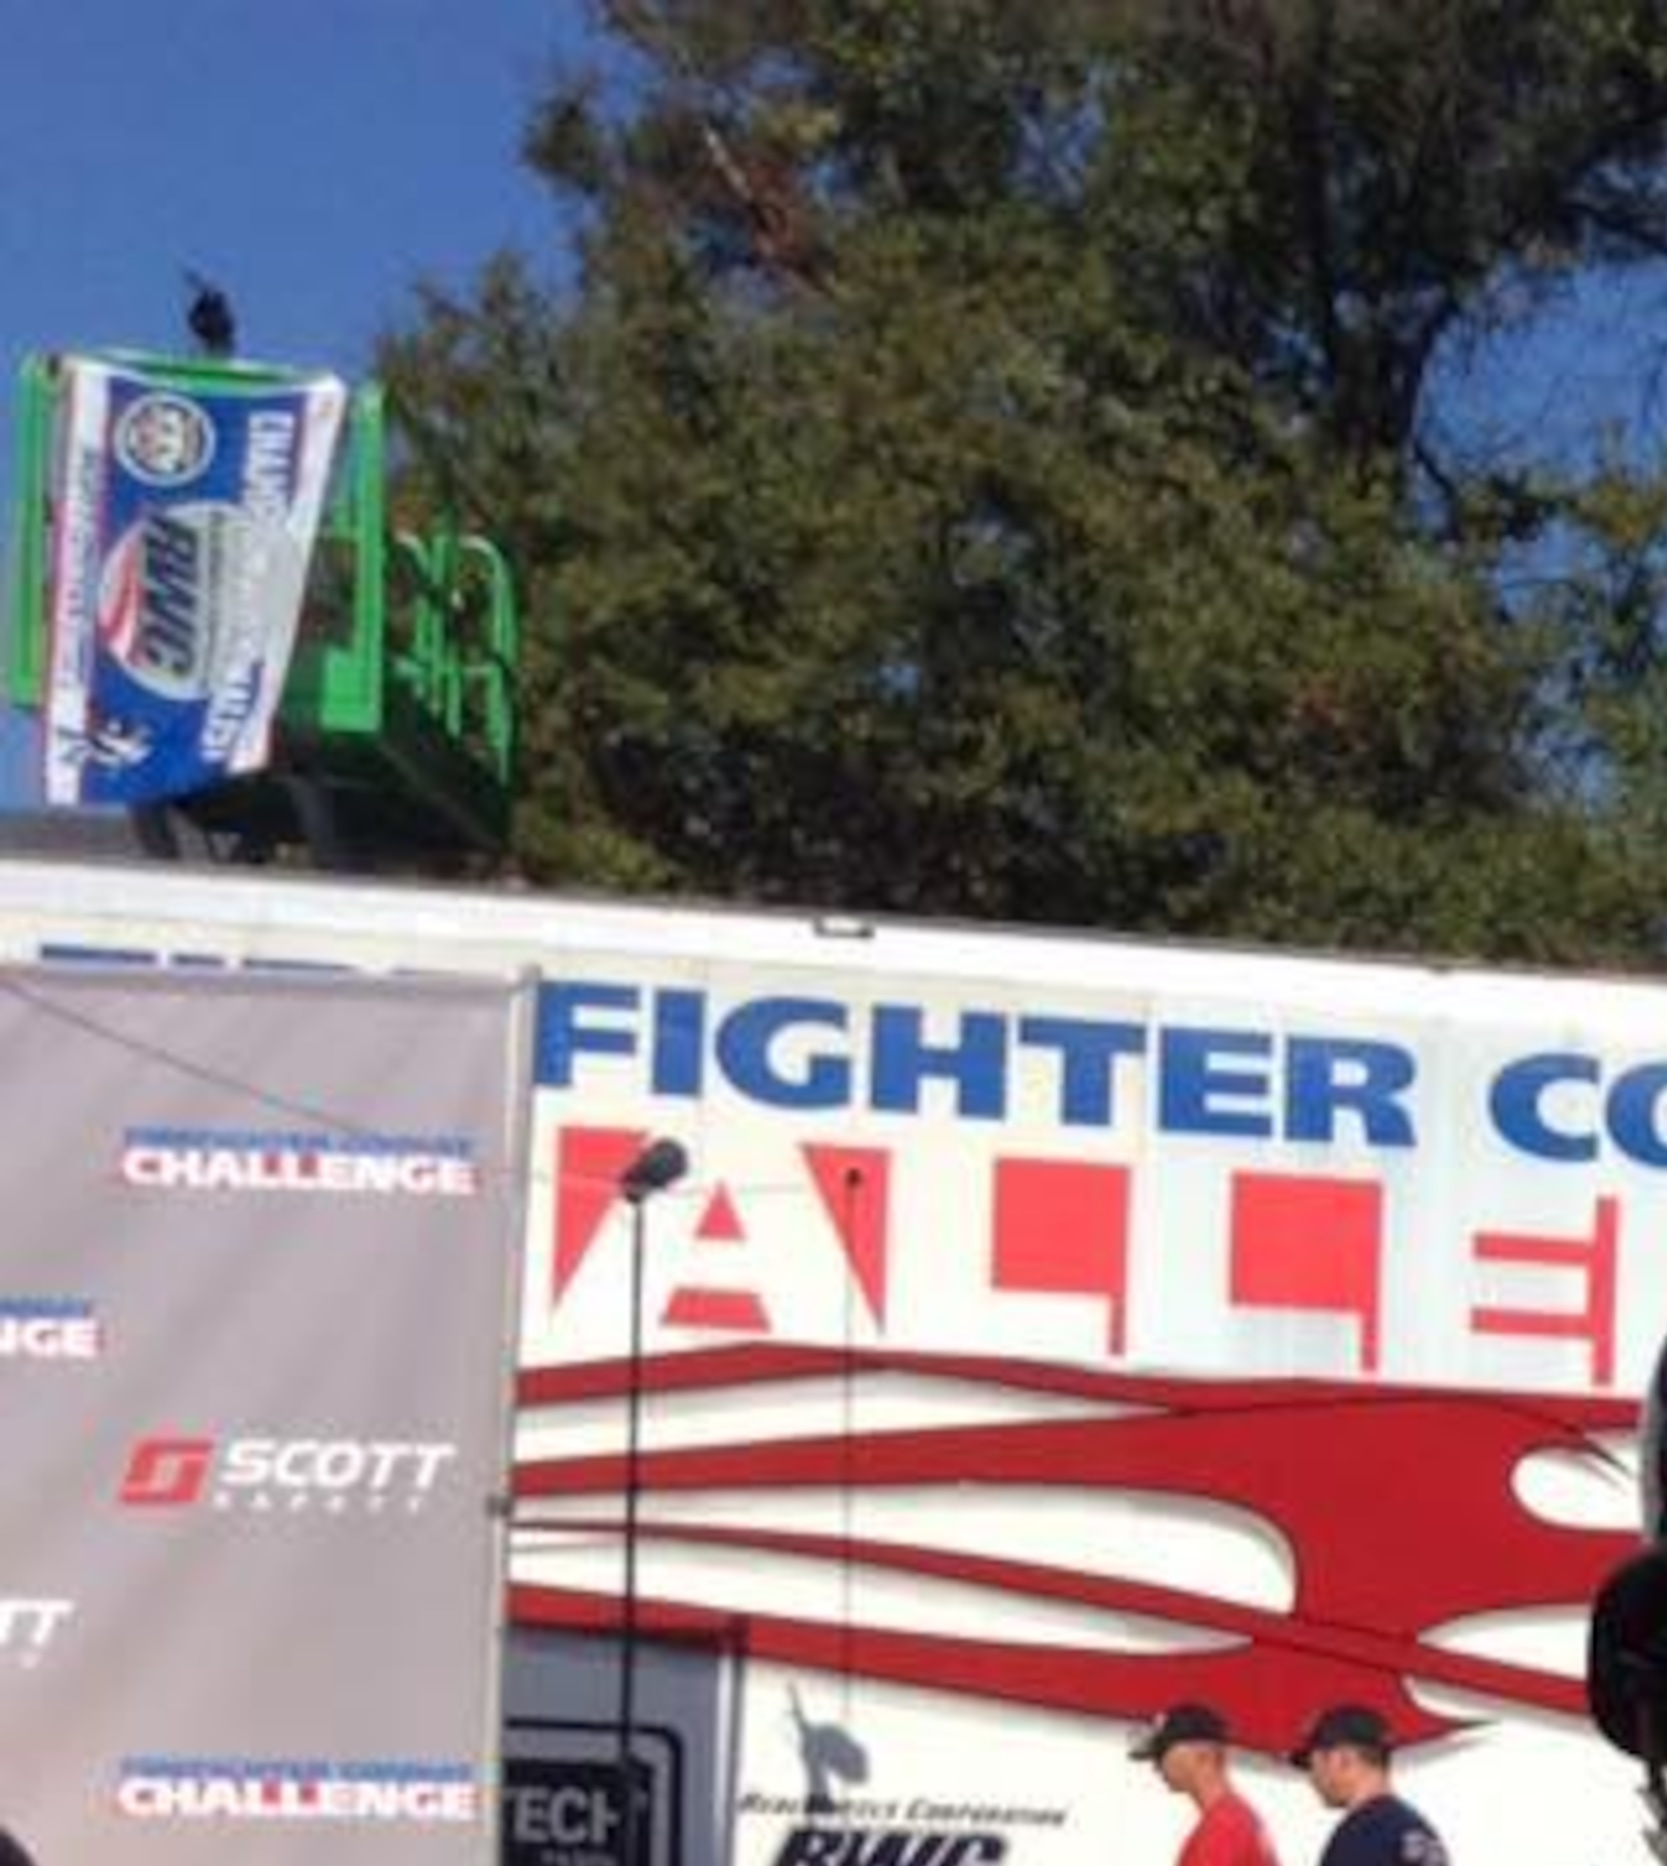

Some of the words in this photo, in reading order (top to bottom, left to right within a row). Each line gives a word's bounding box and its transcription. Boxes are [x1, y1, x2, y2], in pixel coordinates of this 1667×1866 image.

[534, 980, 1417, 1148] FIGHTER
[122, 1148, 478, 1195] CHALLENGE
[222, 1438, 457, 1492] SCOTT
[118, 1777, 476, 1820] CHALLENGE
